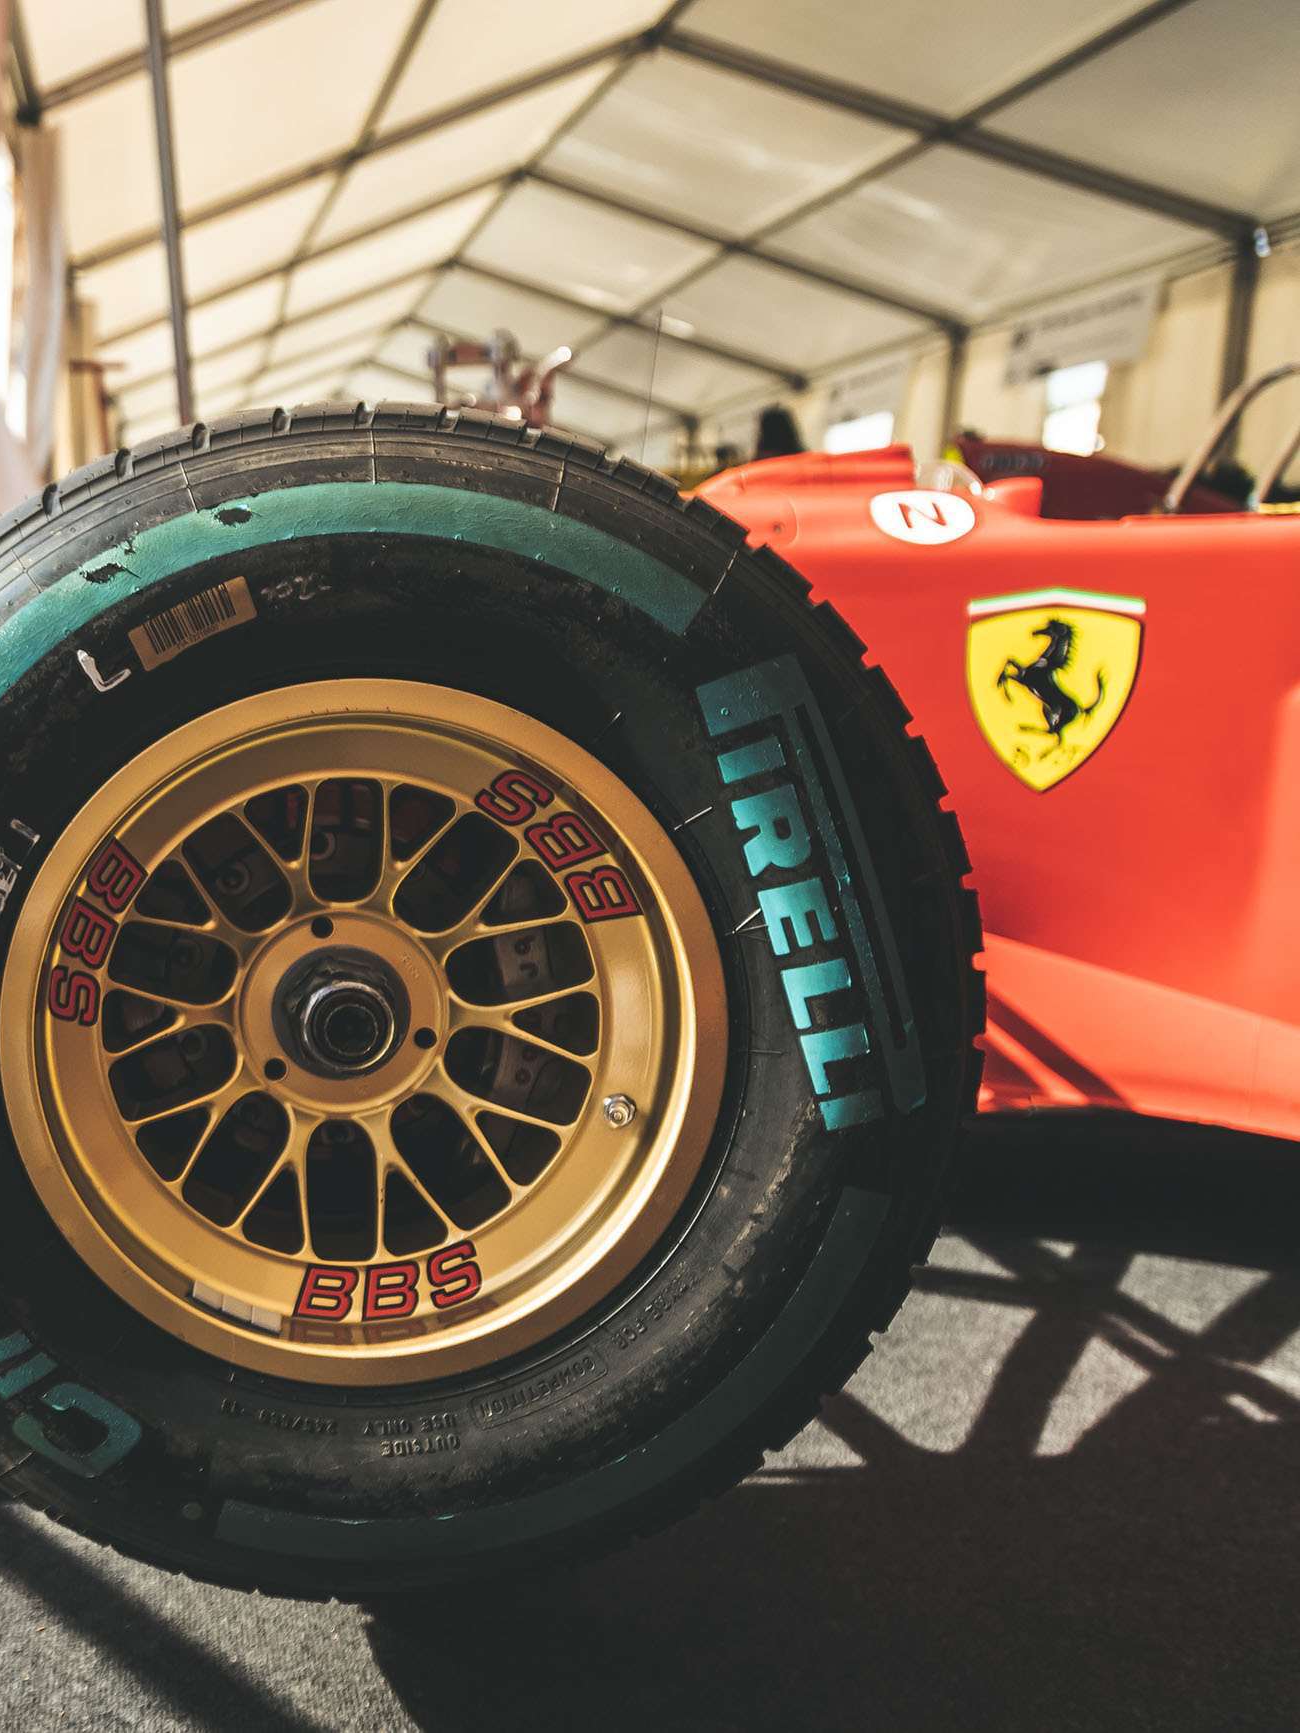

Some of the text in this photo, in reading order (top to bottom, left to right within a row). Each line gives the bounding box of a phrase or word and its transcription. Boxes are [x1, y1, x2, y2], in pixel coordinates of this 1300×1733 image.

[475, 769, 645, 924] BBS
[696, 653, 927, 1133] PIRELLI
[48, 834, 150, 1027] BBS
[292, 1239, 483, 1323] BBS
[379, 1433, 461, 1459] OUTSIDE
[479, 1355, 598, 1419] COMPETITION
